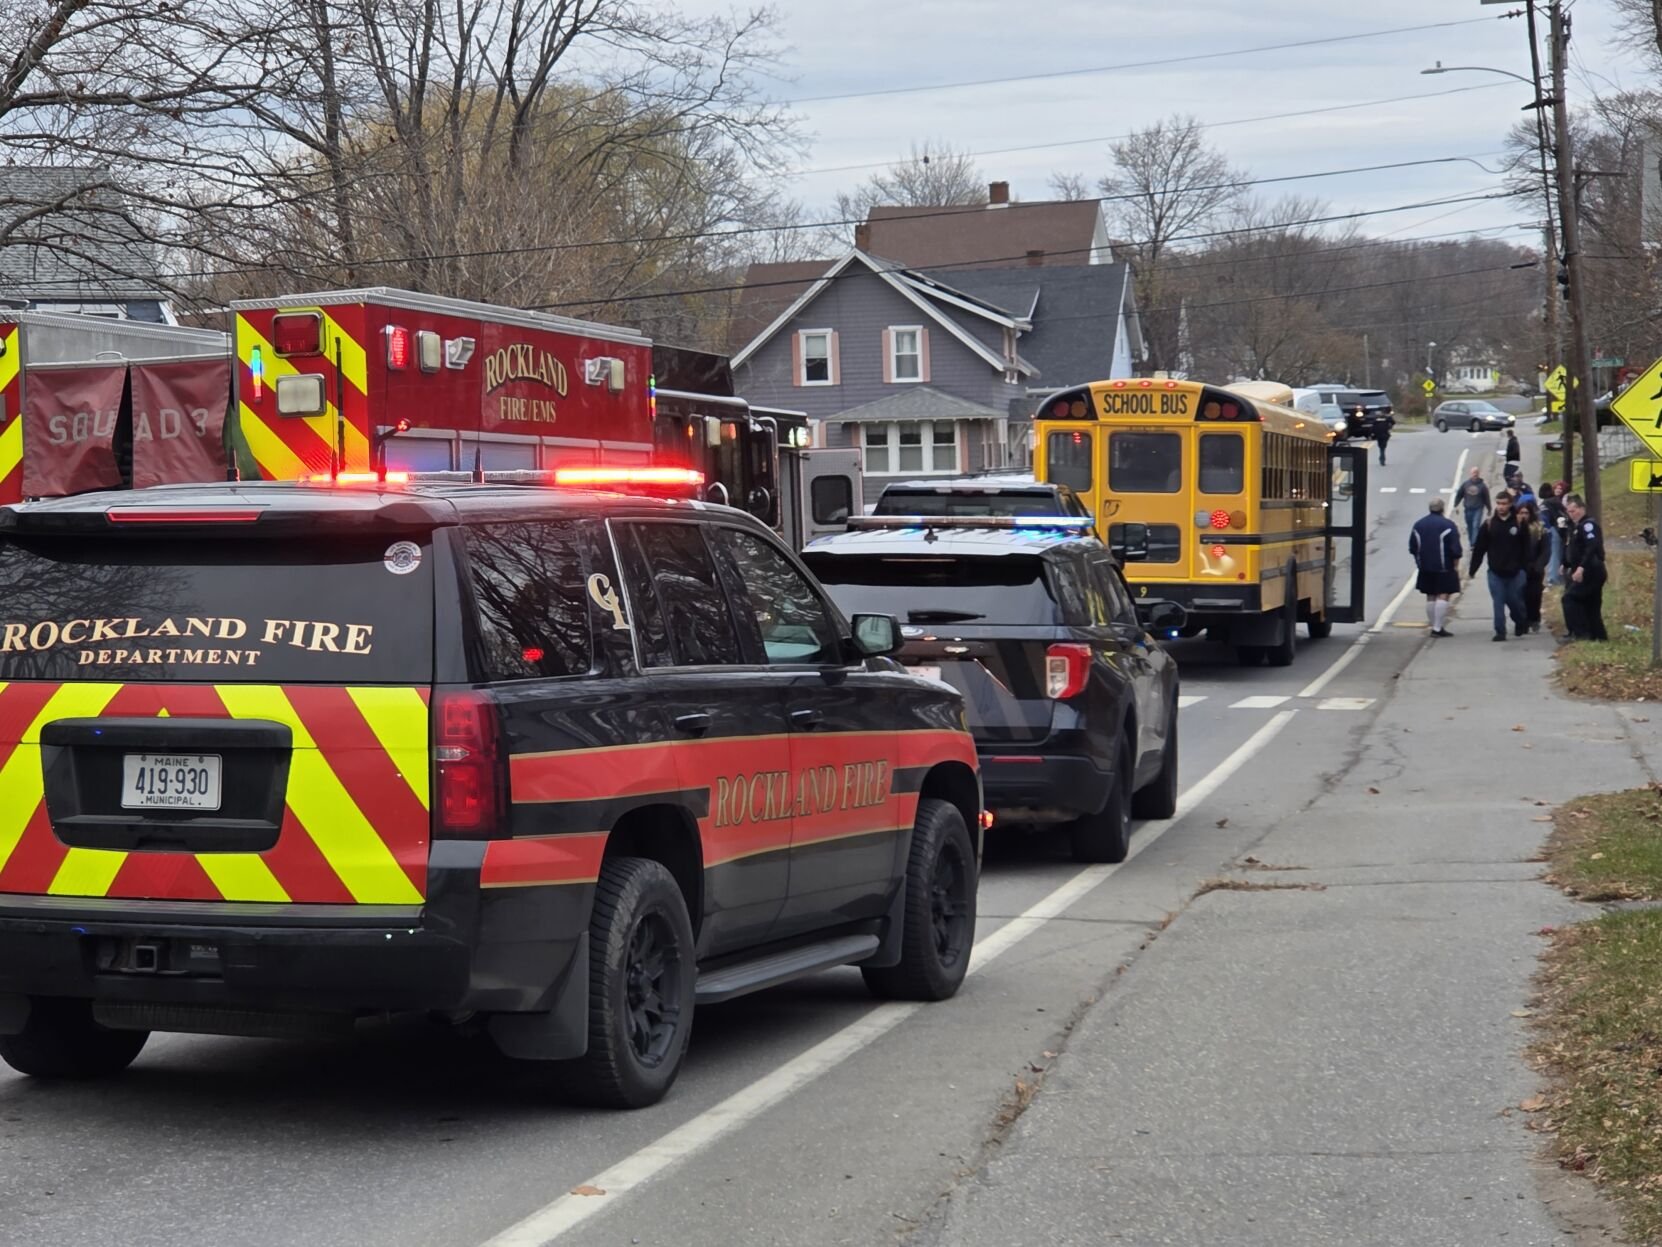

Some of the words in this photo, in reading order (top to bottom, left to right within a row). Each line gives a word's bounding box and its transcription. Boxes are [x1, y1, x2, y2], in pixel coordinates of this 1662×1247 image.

[485, 343, 567, 396] ROCKLAND
[500, 396, 556, 423] FIRE/EMS
[1104, 393, 1157, 414] SCHOOL
[1161, 393, 1188, 414] BUS
[191, 408, 208, 437] 3
[1140, 586, 1148, 598] 9
[0, 617, 247, 652] ROCKLAND
[260, 619, 373, 654] FIRE
[78, 649, 261, 665] DEPARTMENT
[154, 758, 190, 767] MAINE
[145, 795, 195, 806] MUNICIPAL
[715, 766, 838, 828] ROCKLAND
[841, 760, 888, 810] FIRE
